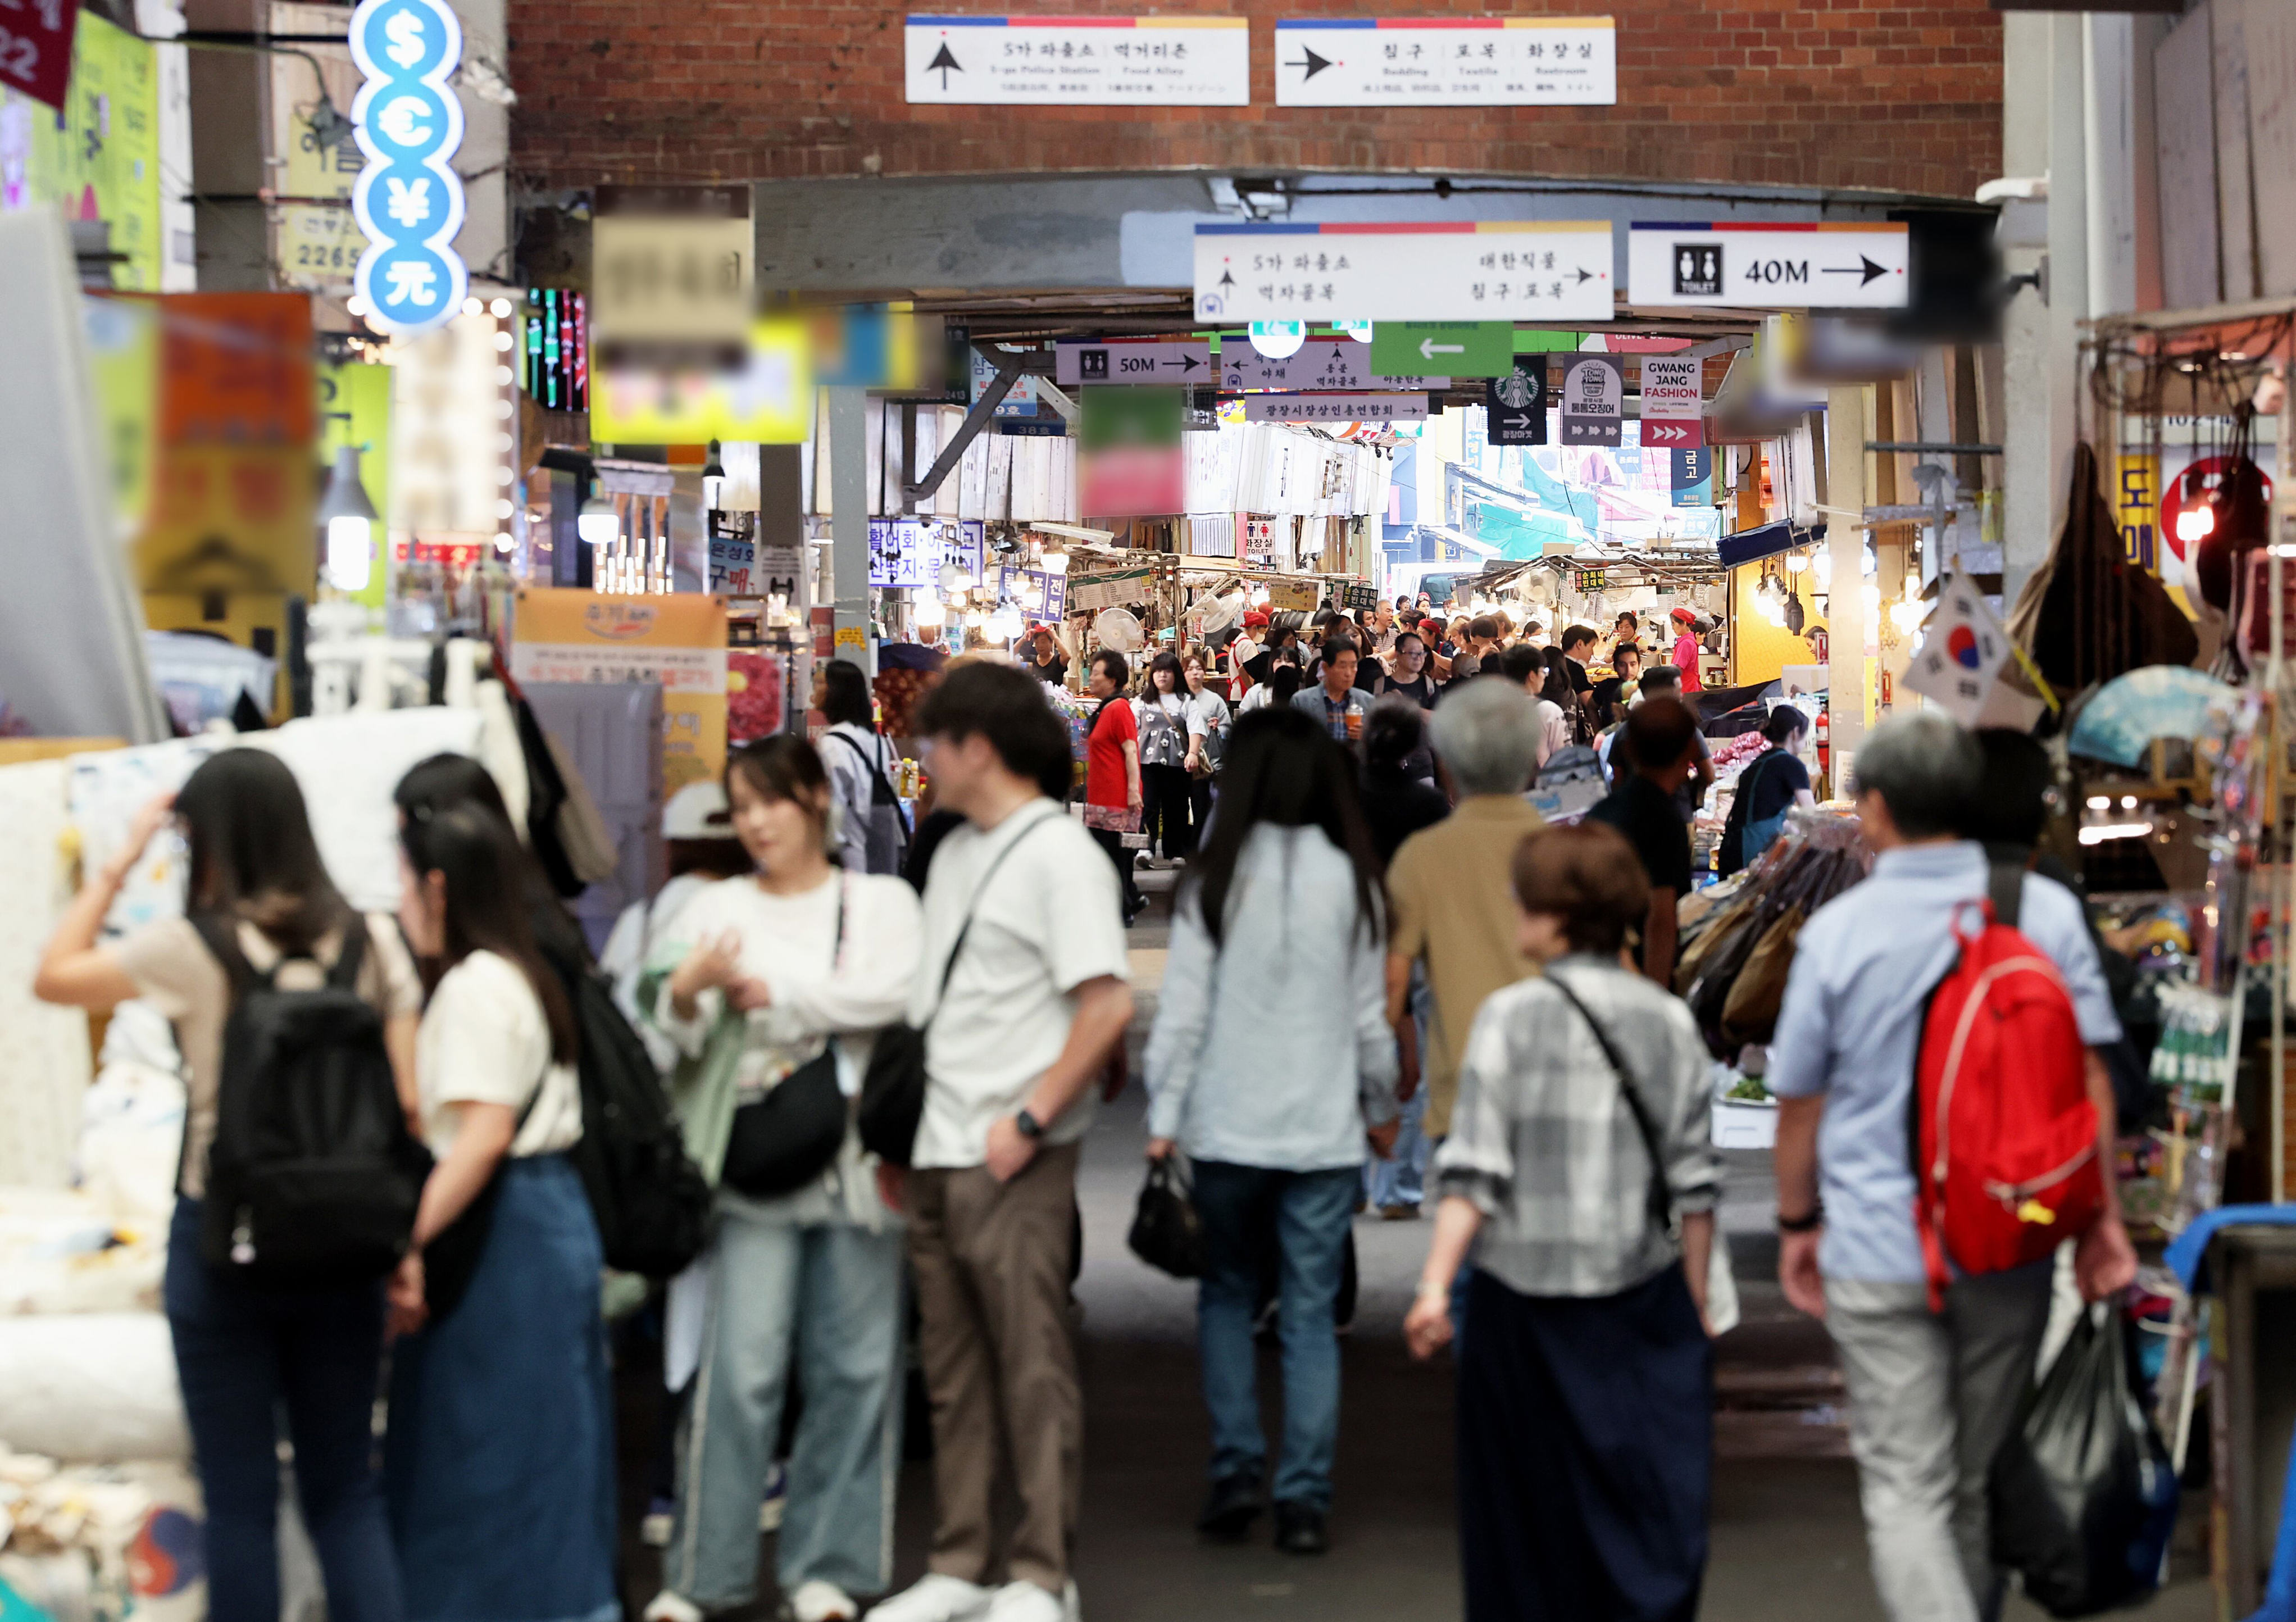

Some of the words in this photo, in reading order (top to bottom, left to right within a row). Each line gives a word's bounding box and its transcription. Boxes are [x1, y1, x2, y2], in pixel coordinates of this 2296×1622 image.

[1745, 260, 1809, 283] 40M
[386, 261, 436, 305] 元
[1120, 357, 1155, 372] 50M
[1649, 363, 1695, 374] GWANG
[1262, 369, 1285, 379] 야채
[1656, 376, 1687, 385] JANG
[1645, 388, 1697, 398] FASHION
[1247, 538, 1272, 548] 화장실
[1352, 587, 1377, 599] 순희네
